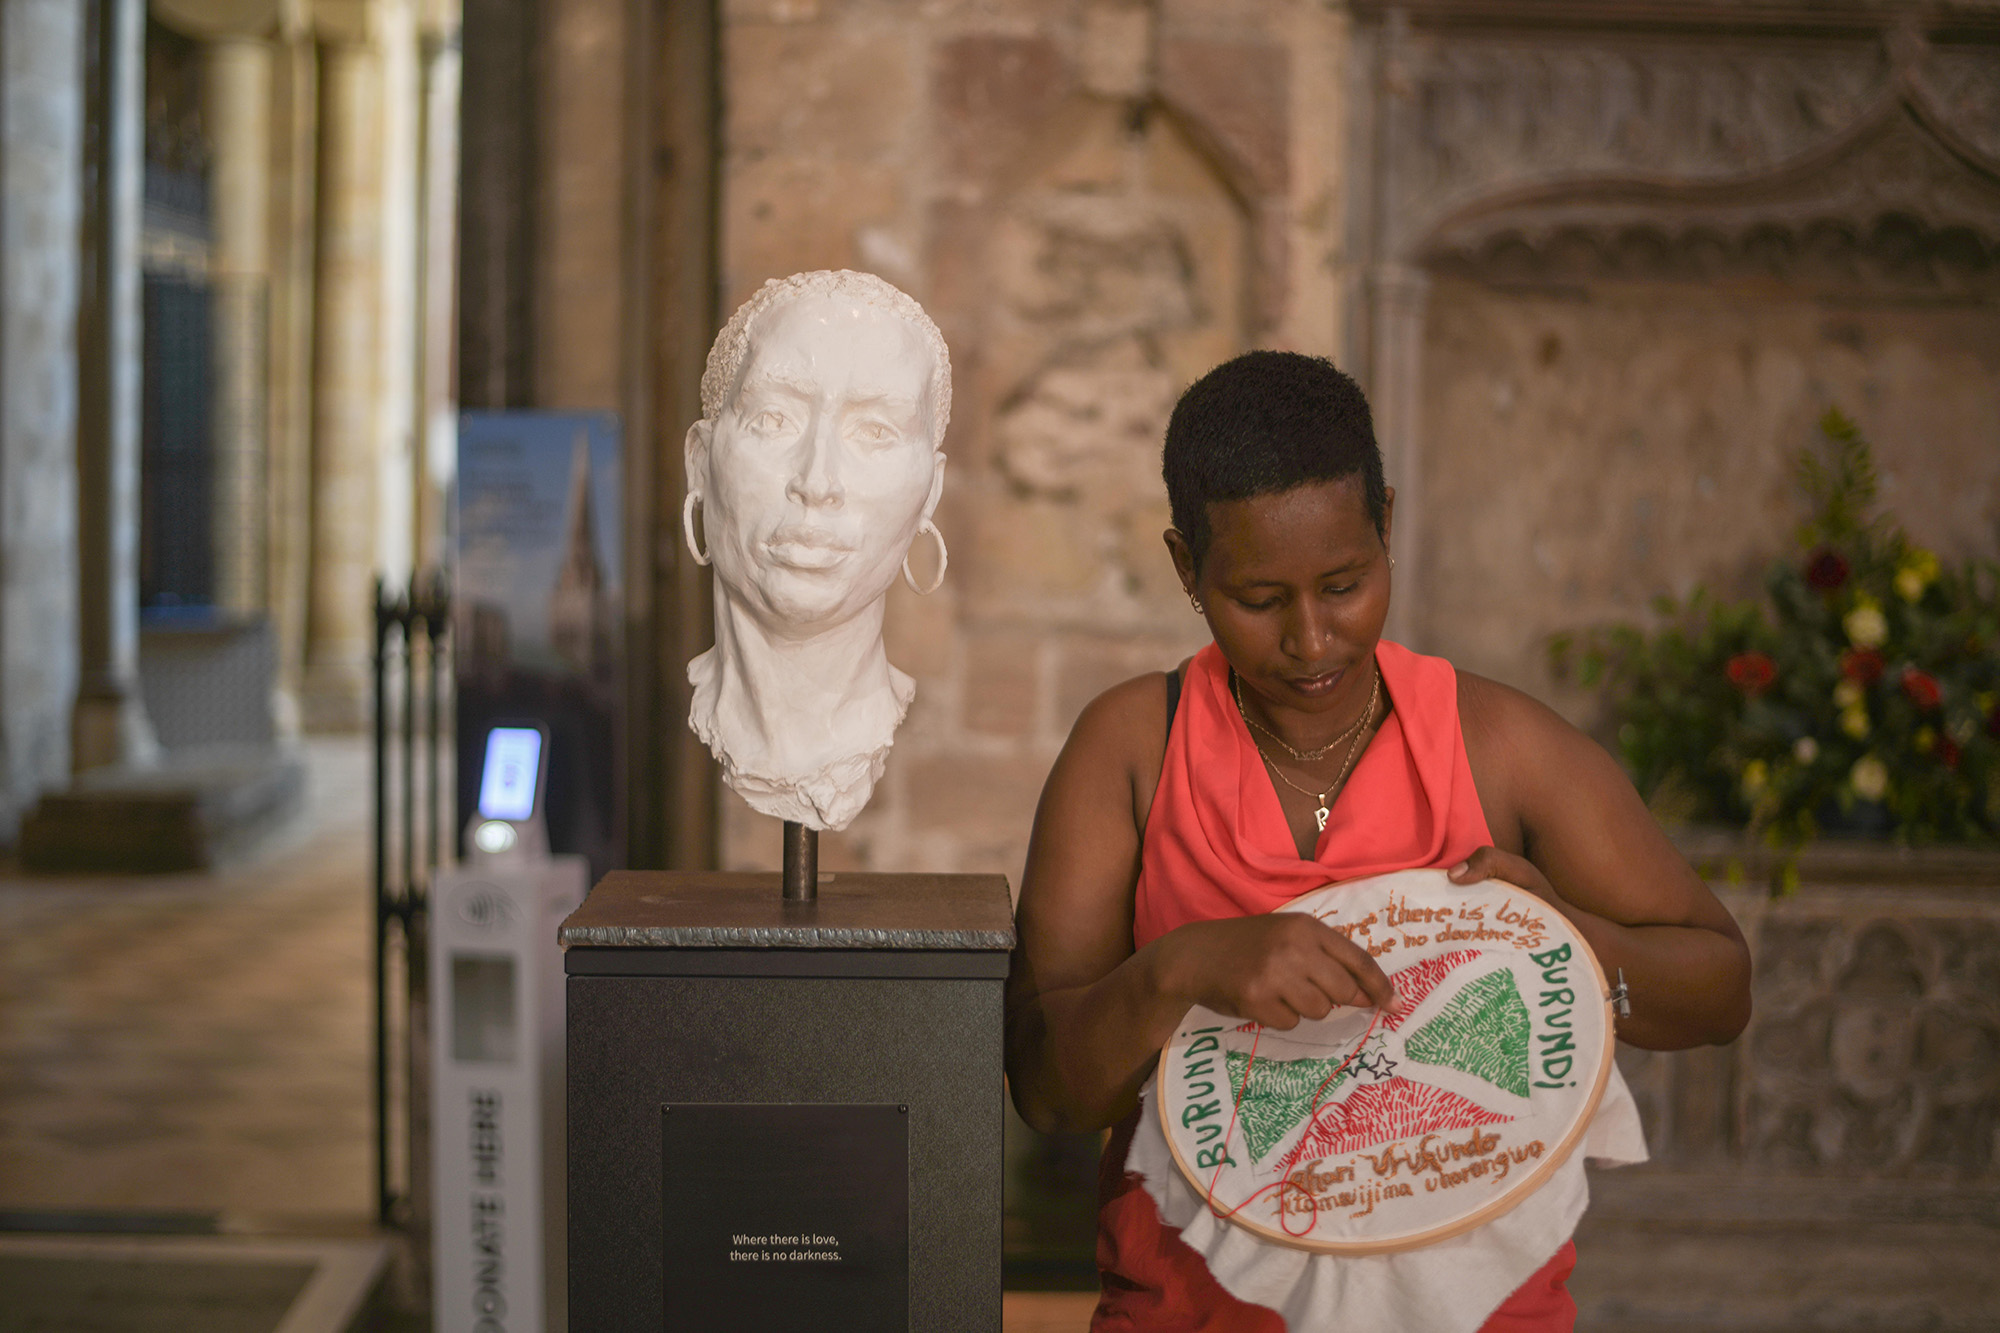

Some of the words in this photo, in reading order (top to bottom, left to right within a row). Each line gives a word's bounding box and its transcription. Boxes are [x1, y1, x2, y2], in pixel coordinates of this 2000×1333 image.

[1379, 889, 1454, 927] there
[1458, 901, 1489, 920] is
[1366, 936, 1397, 958] be
[1403, 934, 1429, 949] no
[732, 1233, 768, 1245] Where
[770, 1233, 799, 1245] there
[801, 1233, 810, 1245] is
[812, 1233, 839, 1247] love,
[729, 1249, 759, 1261] there
[761, 1249, 770, 1261] is
[772, 1251, 788, 1261] no
[789, 1249, 842, 1261] darkness.
